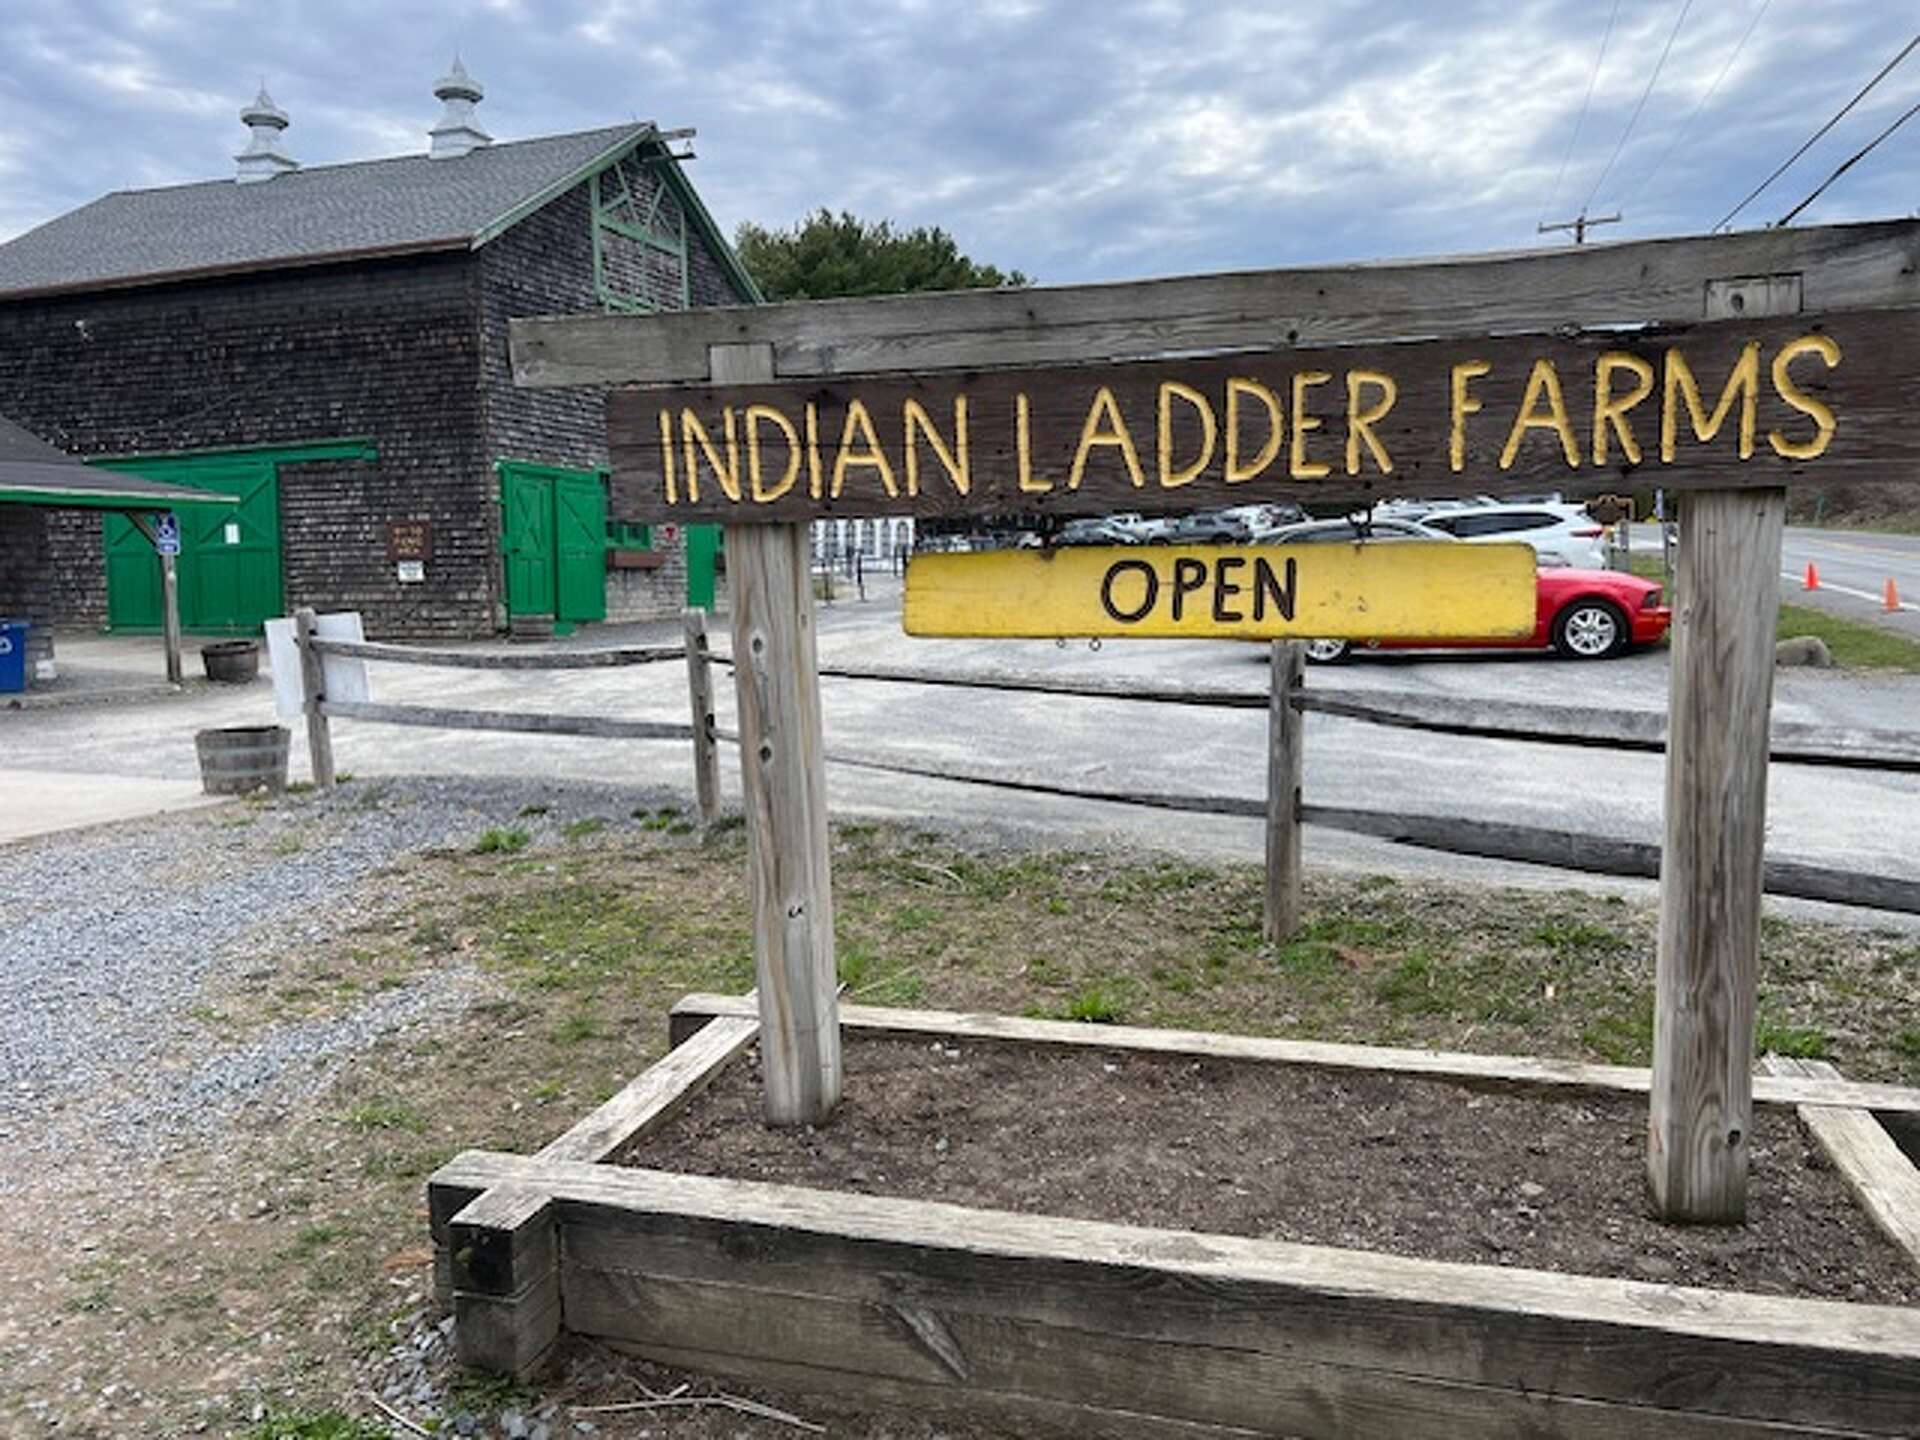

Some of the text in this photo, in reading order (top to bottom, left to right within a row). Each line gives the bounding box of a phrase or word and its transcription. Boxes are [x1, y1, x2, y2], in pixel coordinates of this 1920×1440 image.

[660, 335, 1840, 504] INDIAN LADDER FARMS
[1101, 557, 1296, 623] OPEN
